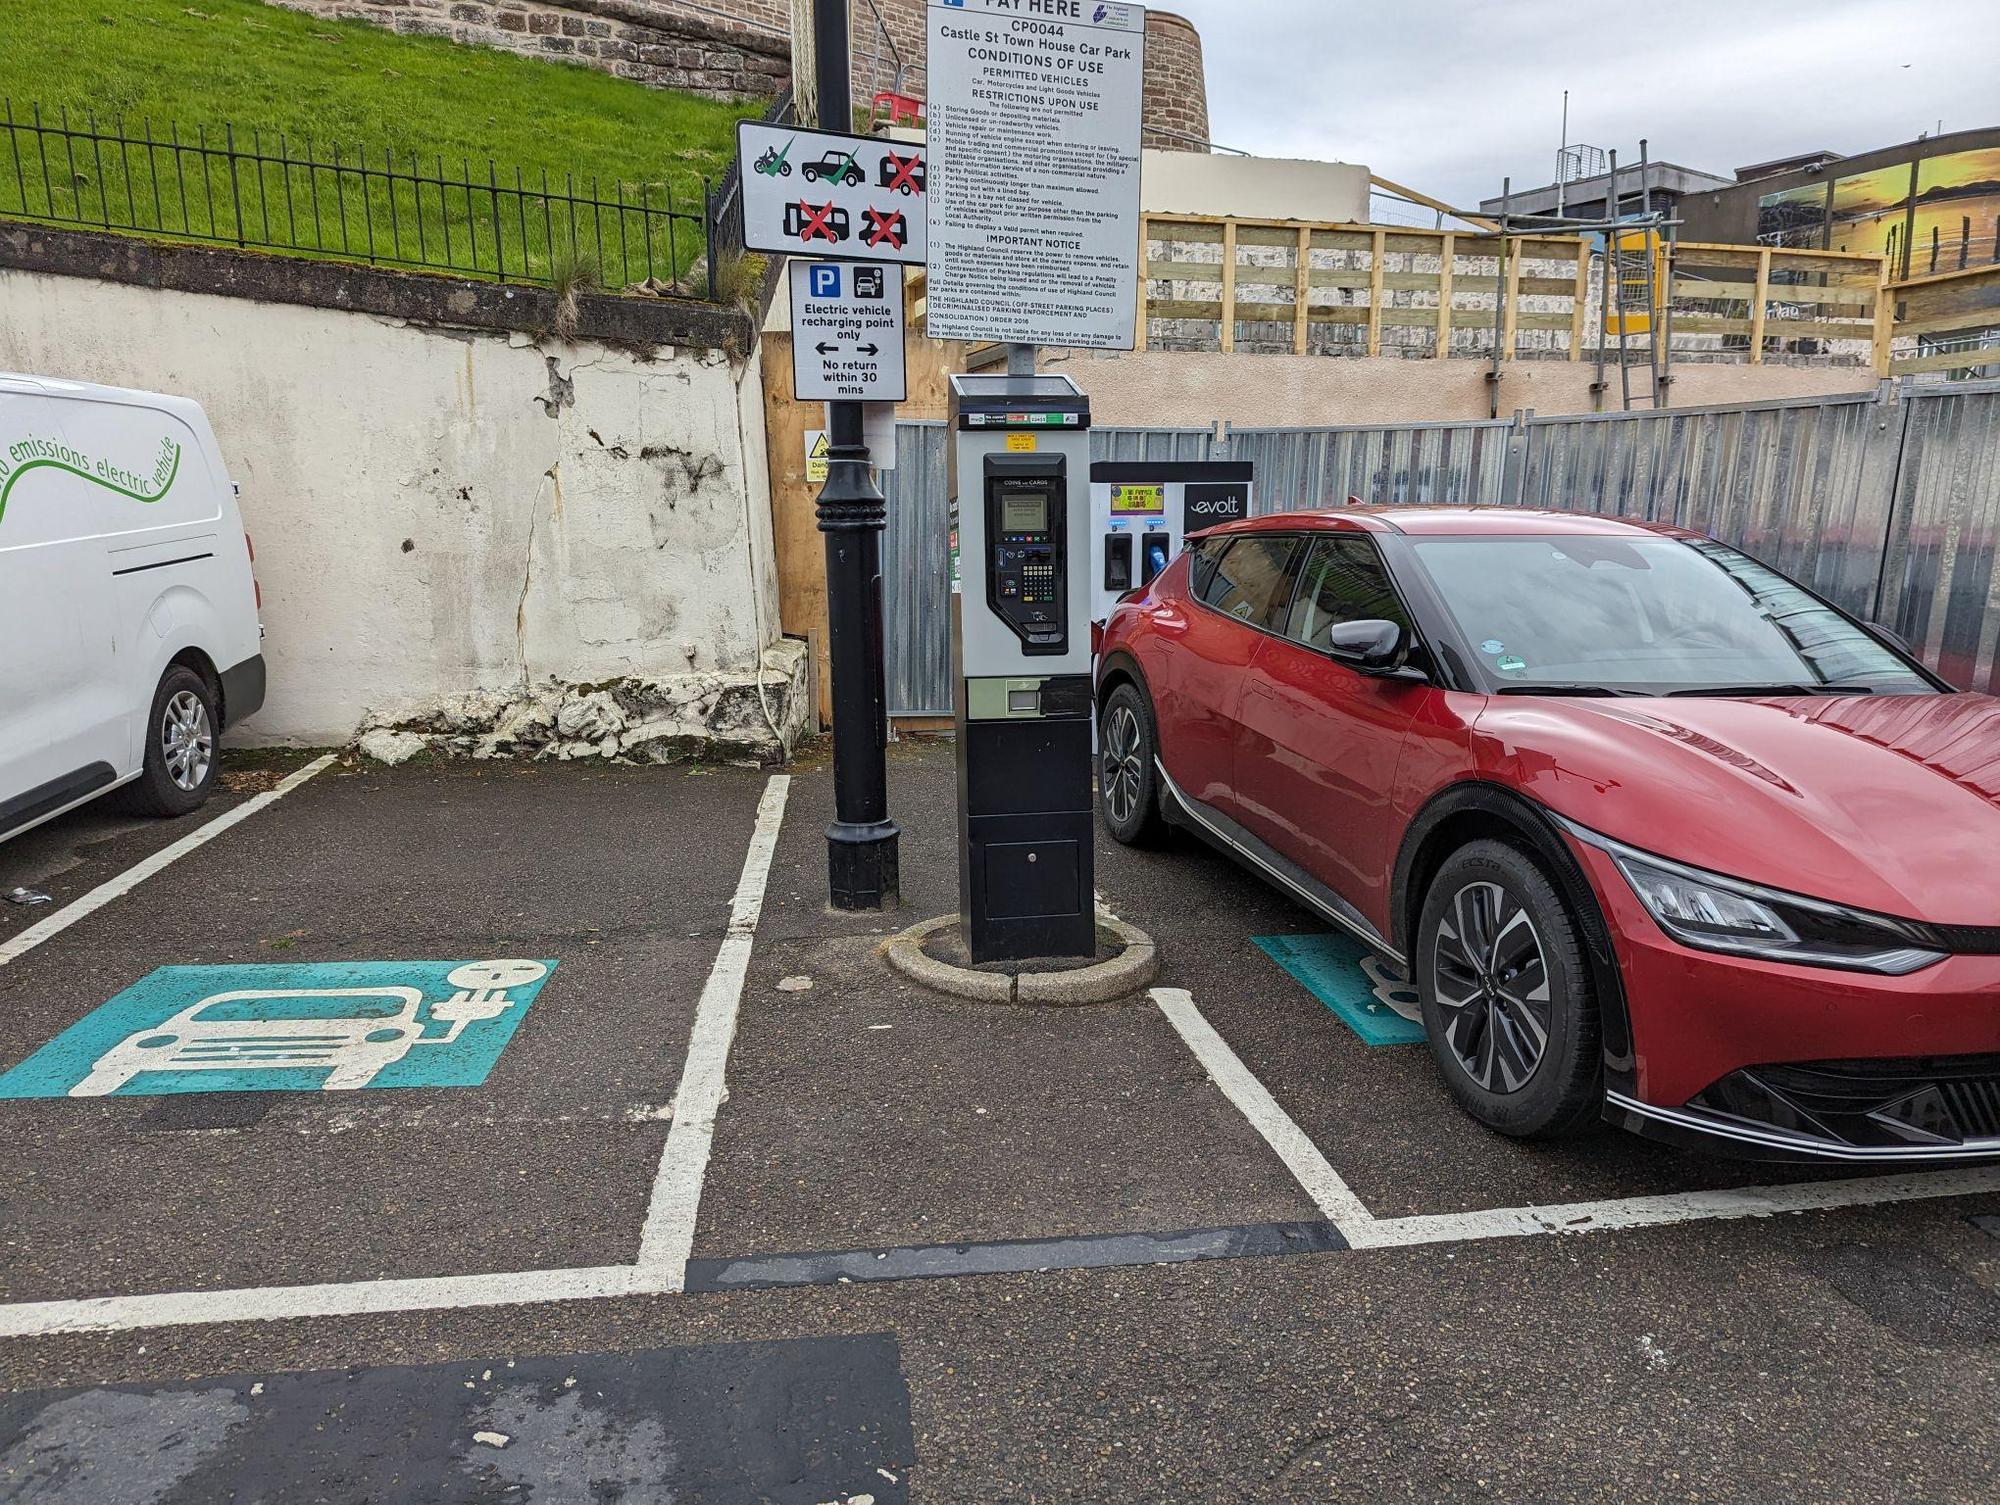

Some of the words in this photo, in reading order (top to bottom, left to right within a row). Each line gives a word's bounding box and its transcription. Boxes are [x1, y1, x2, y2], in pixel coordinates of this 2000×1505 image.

[1029, 0, 1081, 18] HERE
[1011, 21, 1064, 37] CP0044
[941, 25, 980, 41] Castle
[985, 31, 999, 44] St
[1003, 33, 1034, 48] Town
[1039, 38, 1075, 53] House
[1079, 43, 1100, 56] Car
[1105, 46, 1131, 59] Park
[968, 48, 1052, 68] CONDITIONS
[1057, 58, 1074, 70] OF
[1078, 61, 1104, 74] USE
[983, 67, 1038, 81] PERMITTED
[1041, 74, 1089, 87] VEHICLES
[987, 80, 1025, 90] Motorcycles
[1076, 90, 1101, 98] Vehicles
[972, 89, 1045, 105] RESTRICTIONS
[1048, 97, 1076, 108] UPON
[1079, 101, 1099, 111] USE
[1001, 103, 1030, 112] following
[1054, 109, 1083, 117] permitted
[987, 235, 1043, 247] IMPORTANT
[1045, 239, 1081, 250] NOTICE
[817, 269, 835, 294] P
[805, 304, 849, 315] Electric
[852, 305, 891, 316] vehicle
[802, 317, 862, 328] recharging
[865, 318, 894, 328] point
[837, 331, 861, 341] only
[823, 360, 839, 370] No
[842, 361, 877, 370] return
[823, 372, 858, 382] within
[861, 372, 877, 382] 30
[838, 385, 864, 395] mins
[9, 433, 90, 471] emissions
[96, 458, 152, 496] electric
[152, 436, 175, 488] vehicle
[1190, 496, 1239, 514] evolt
